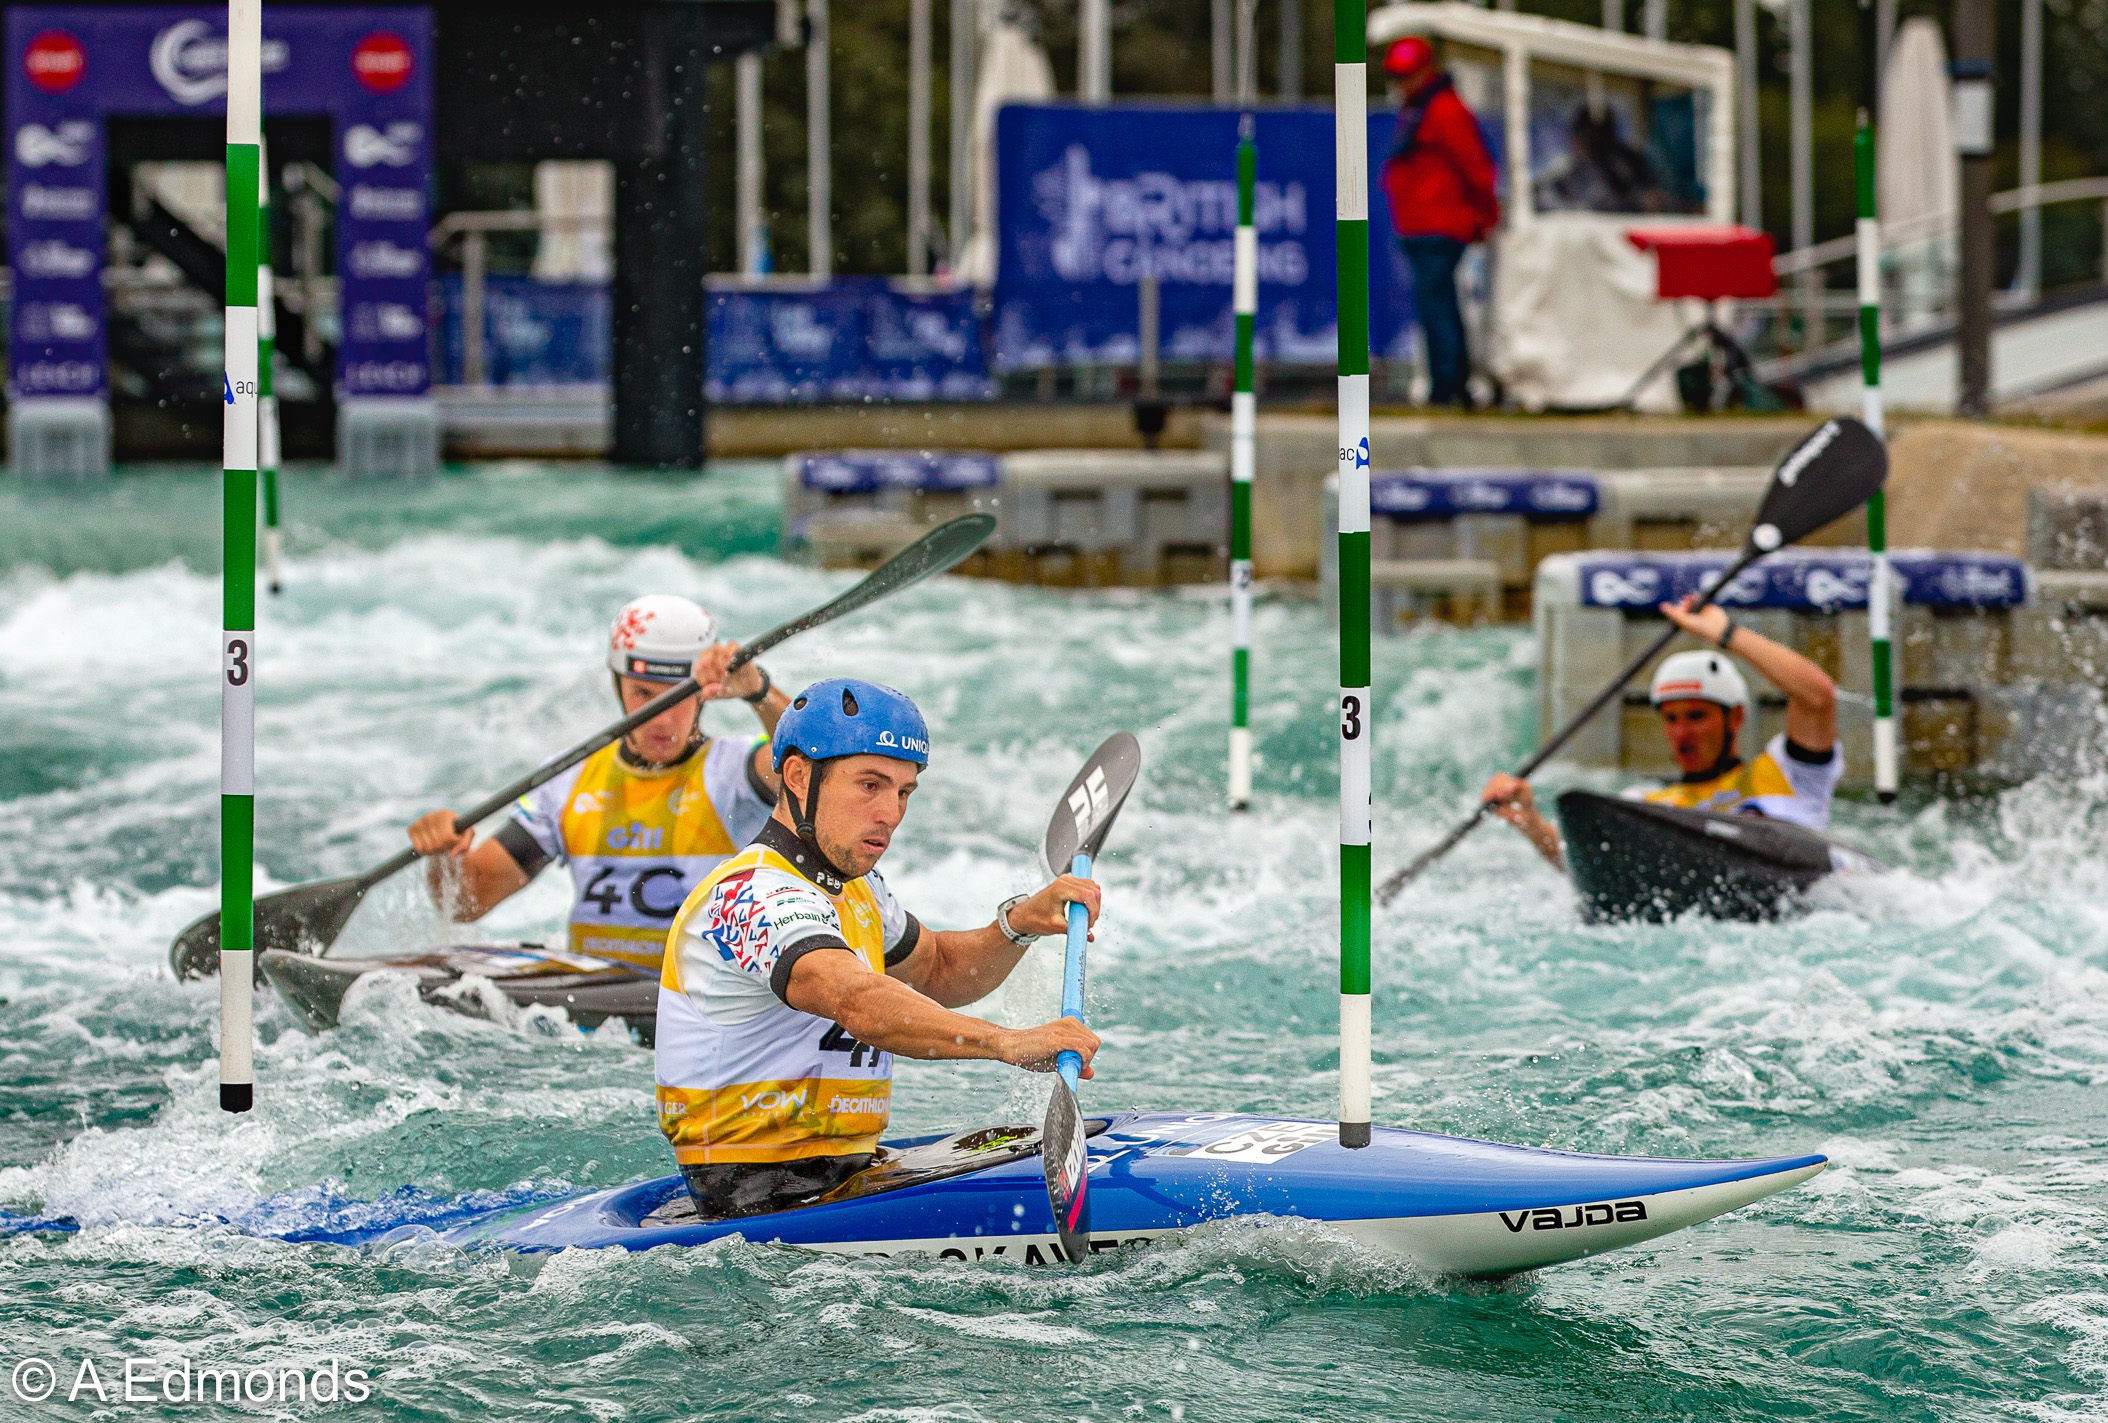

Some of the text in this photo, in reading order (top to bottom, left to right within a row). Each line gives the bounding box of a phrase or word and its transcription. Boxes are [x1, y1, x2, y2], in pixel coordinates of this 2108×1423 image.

[226, 639, 249, 687] 3
[1341, 695, 1362, 741] 3
[901, 735, 929, 755] UNIQ
[606, 821, 664, 850] Gill
[583, 866, 685, 919] 4C
[818, 1021, 882, 1068] 4
[741, 1088, 808, 1110] VOW
[829, 1097, 889, 1114] DECATHLON
[1204, 1123, 1316, 1154] CZE
